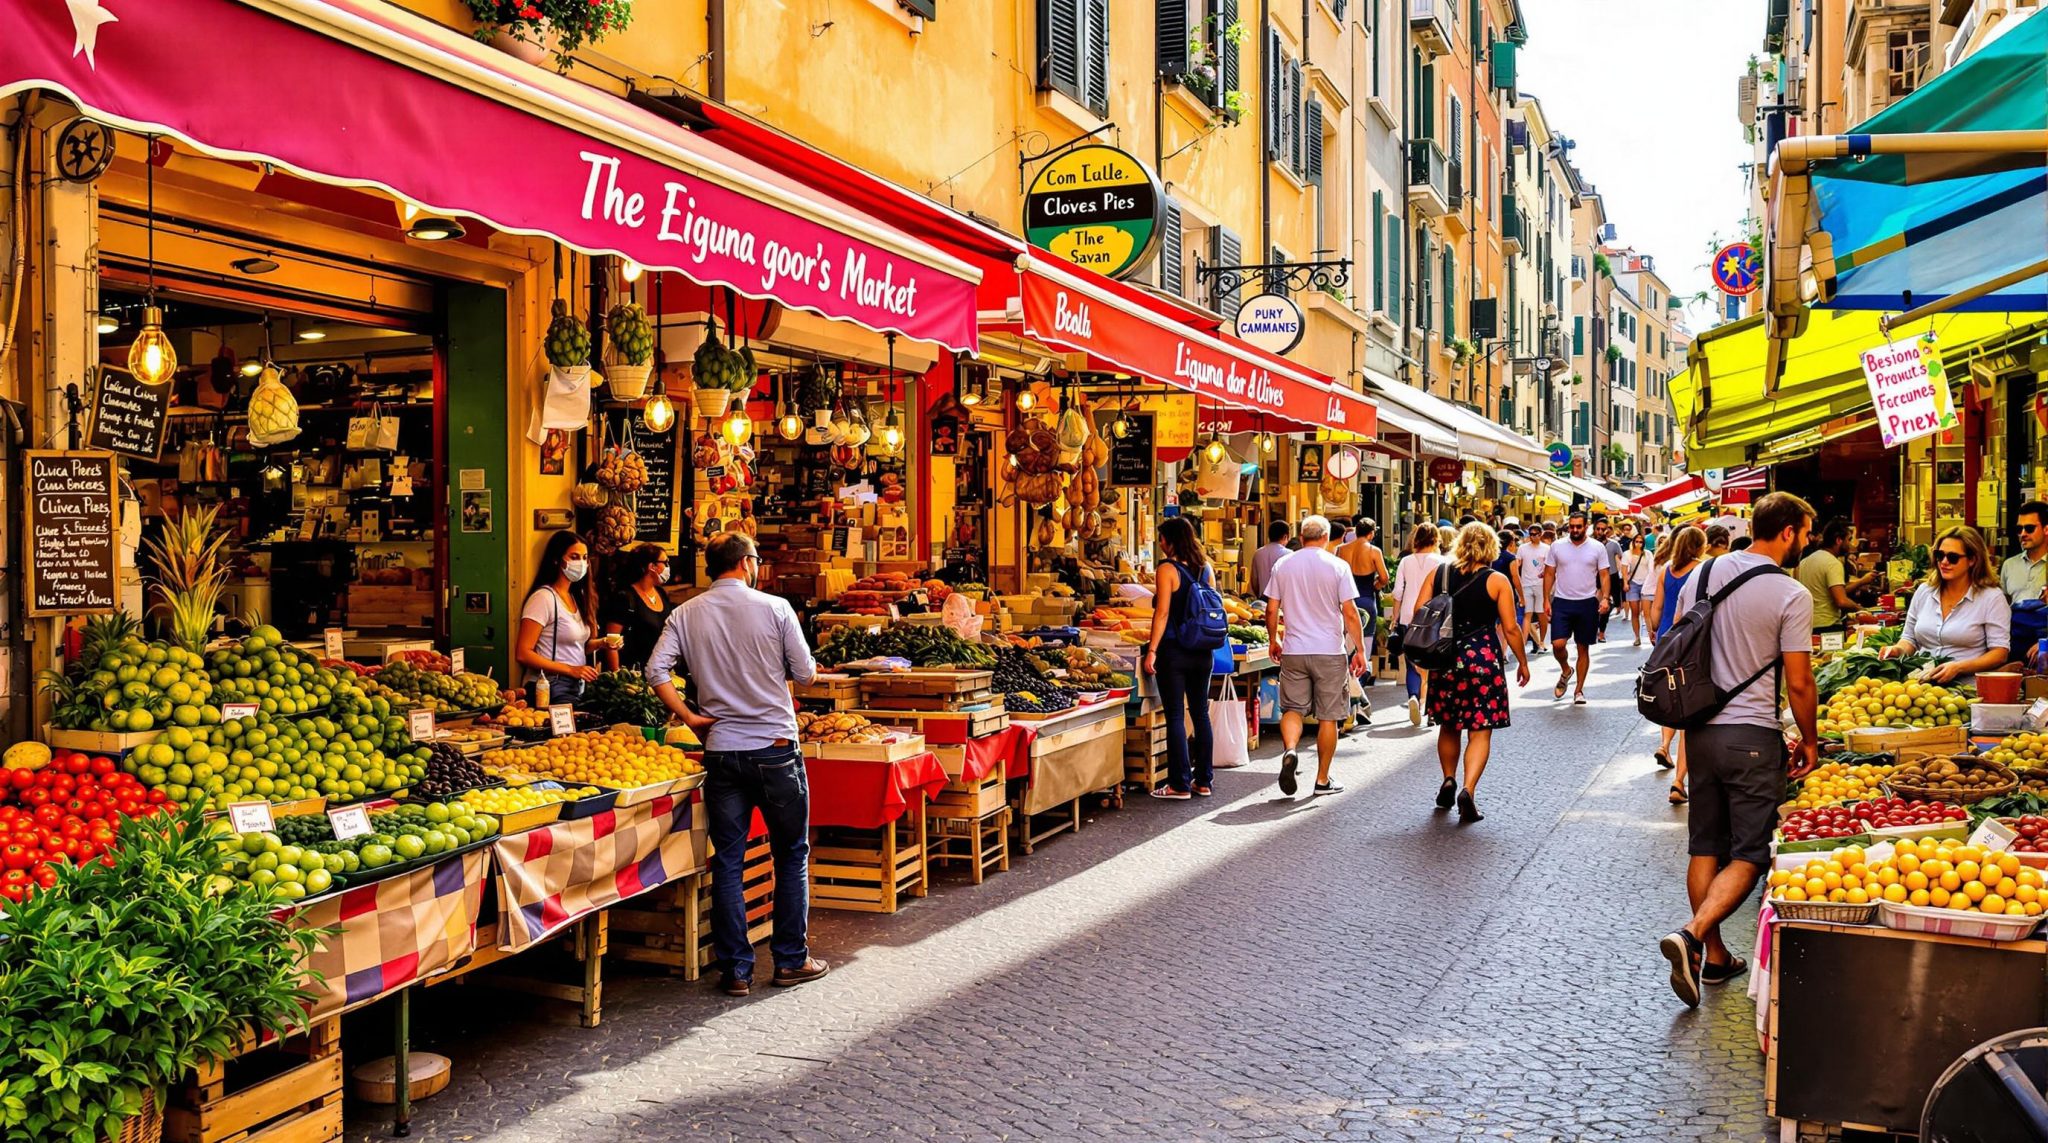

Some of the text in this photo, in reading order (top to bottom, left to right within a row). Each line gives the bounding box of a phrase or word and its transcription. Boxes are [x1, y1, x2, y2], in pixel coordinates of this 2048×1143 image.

[1046, 169, 1077, 186] Com
[1103, 191, 1135, 211] Pies
[579, 150, 918, 318] The Eiguna goor's Market
[1070, 249, 1111, 264] Savan
